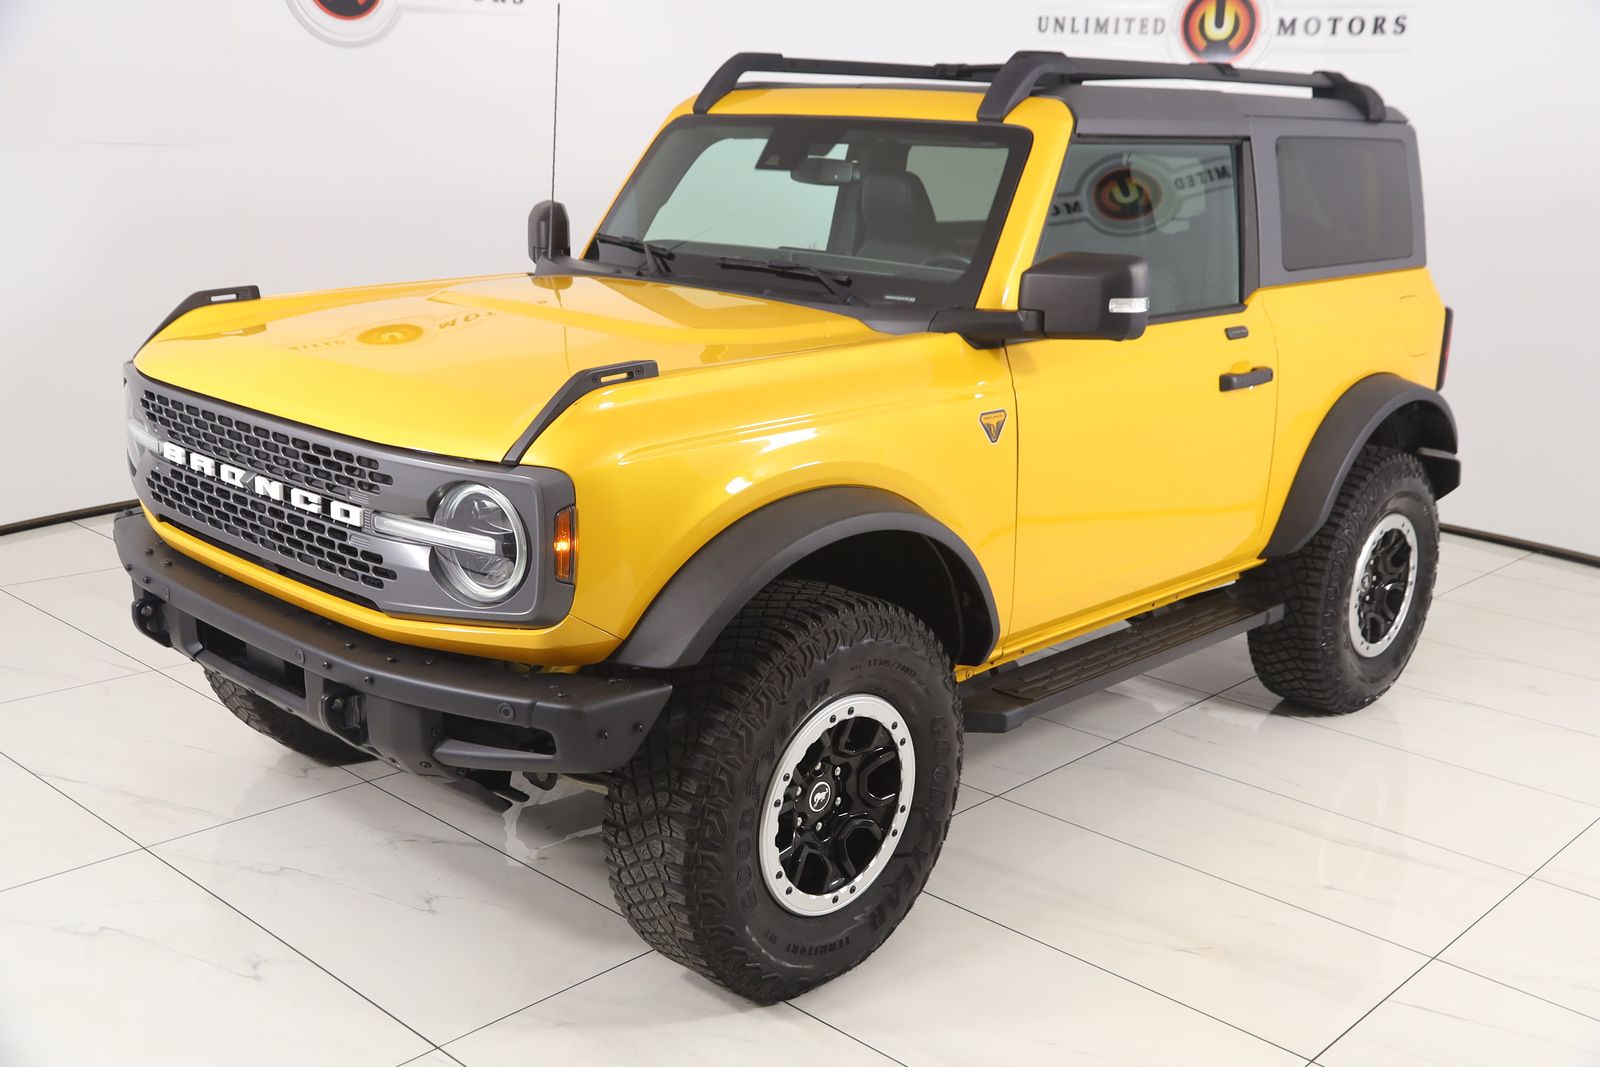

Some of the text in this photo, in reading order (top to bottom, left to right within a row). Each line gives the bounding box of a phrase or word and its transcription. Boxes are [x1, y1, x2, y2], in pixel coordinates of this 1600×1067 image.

[1037, 15, 1167, 35] UNLIMITED
[1276, 15, 1408, 37] MOTORS
[163, 441, 365, 528] BRONCO
